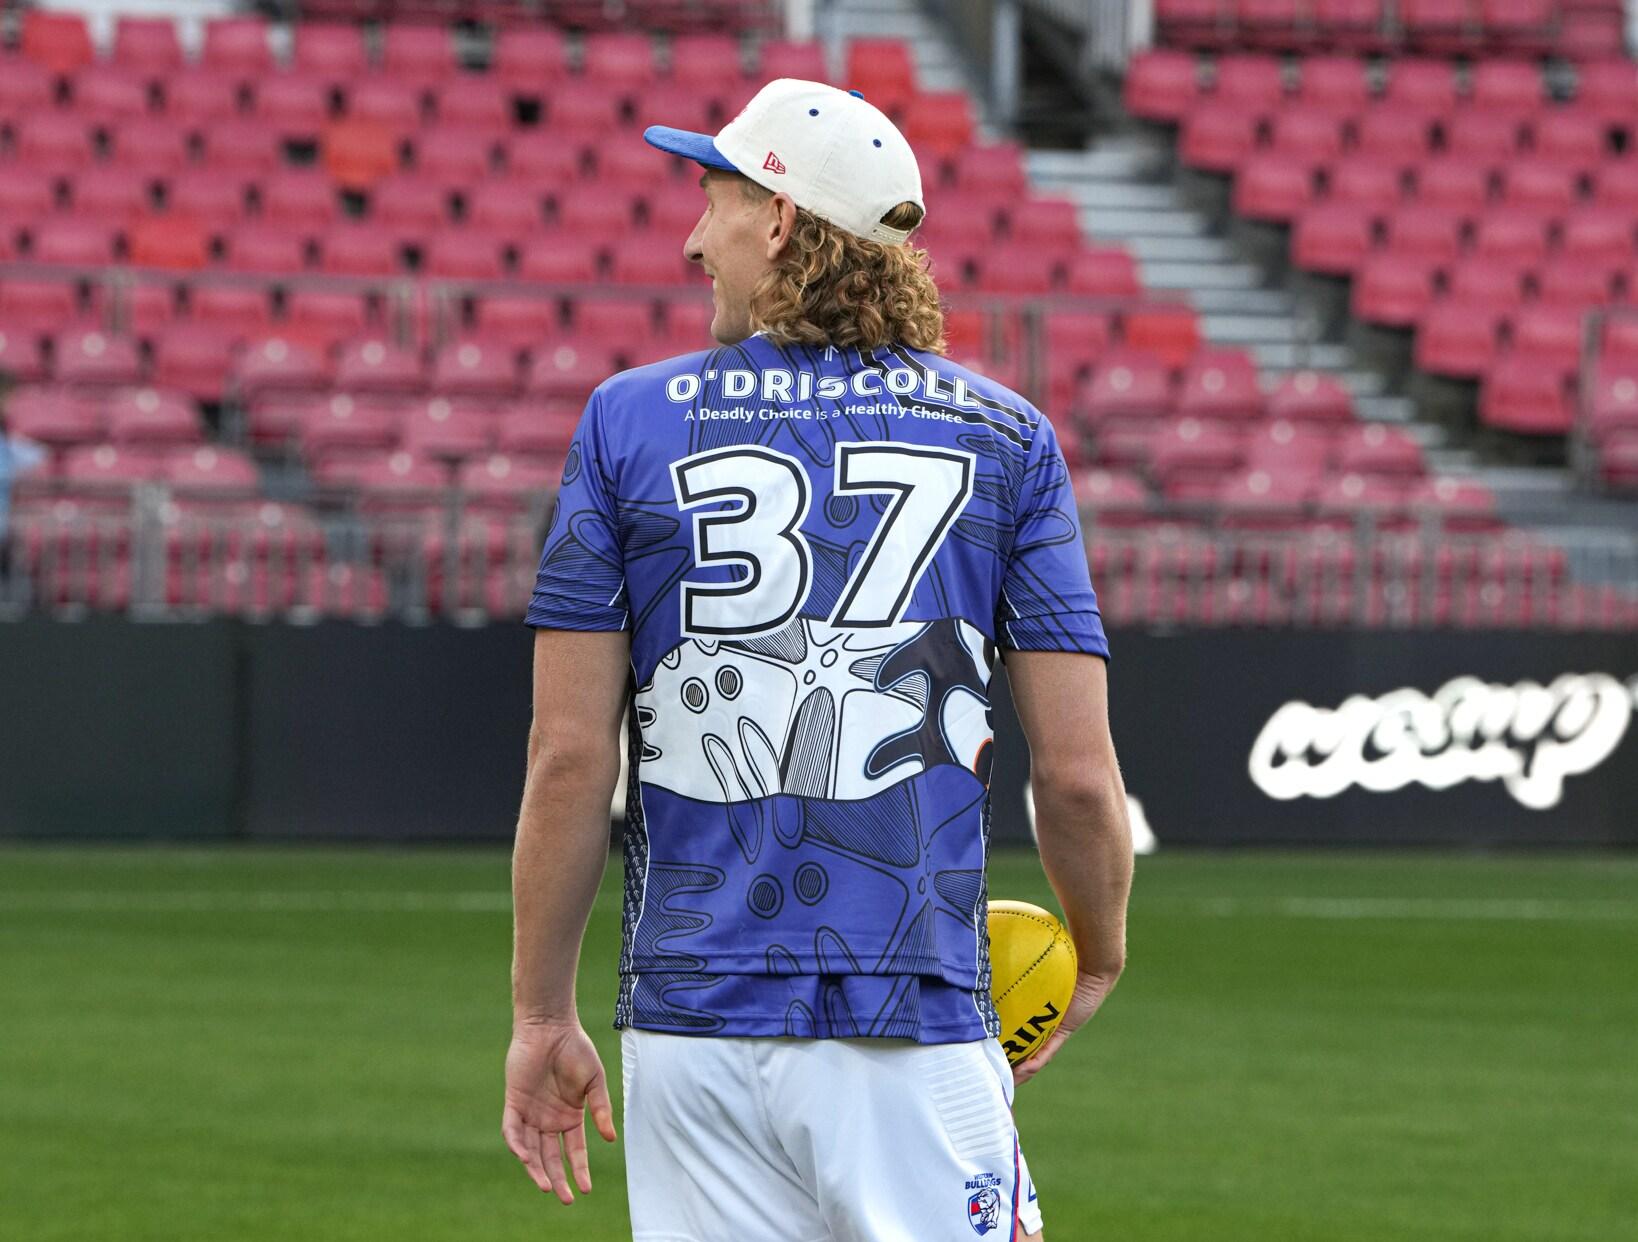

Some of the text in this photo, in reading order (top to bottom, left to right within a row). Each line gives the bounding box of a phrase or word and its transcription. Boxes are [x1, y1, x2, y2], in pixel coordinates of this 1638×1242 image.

[666, 368, 980, 409] O'DRISCOLL
[684, 403, 963, 424] A Deadly Choice is a Healthy Choice
[669, 441, 977, 638] 37
